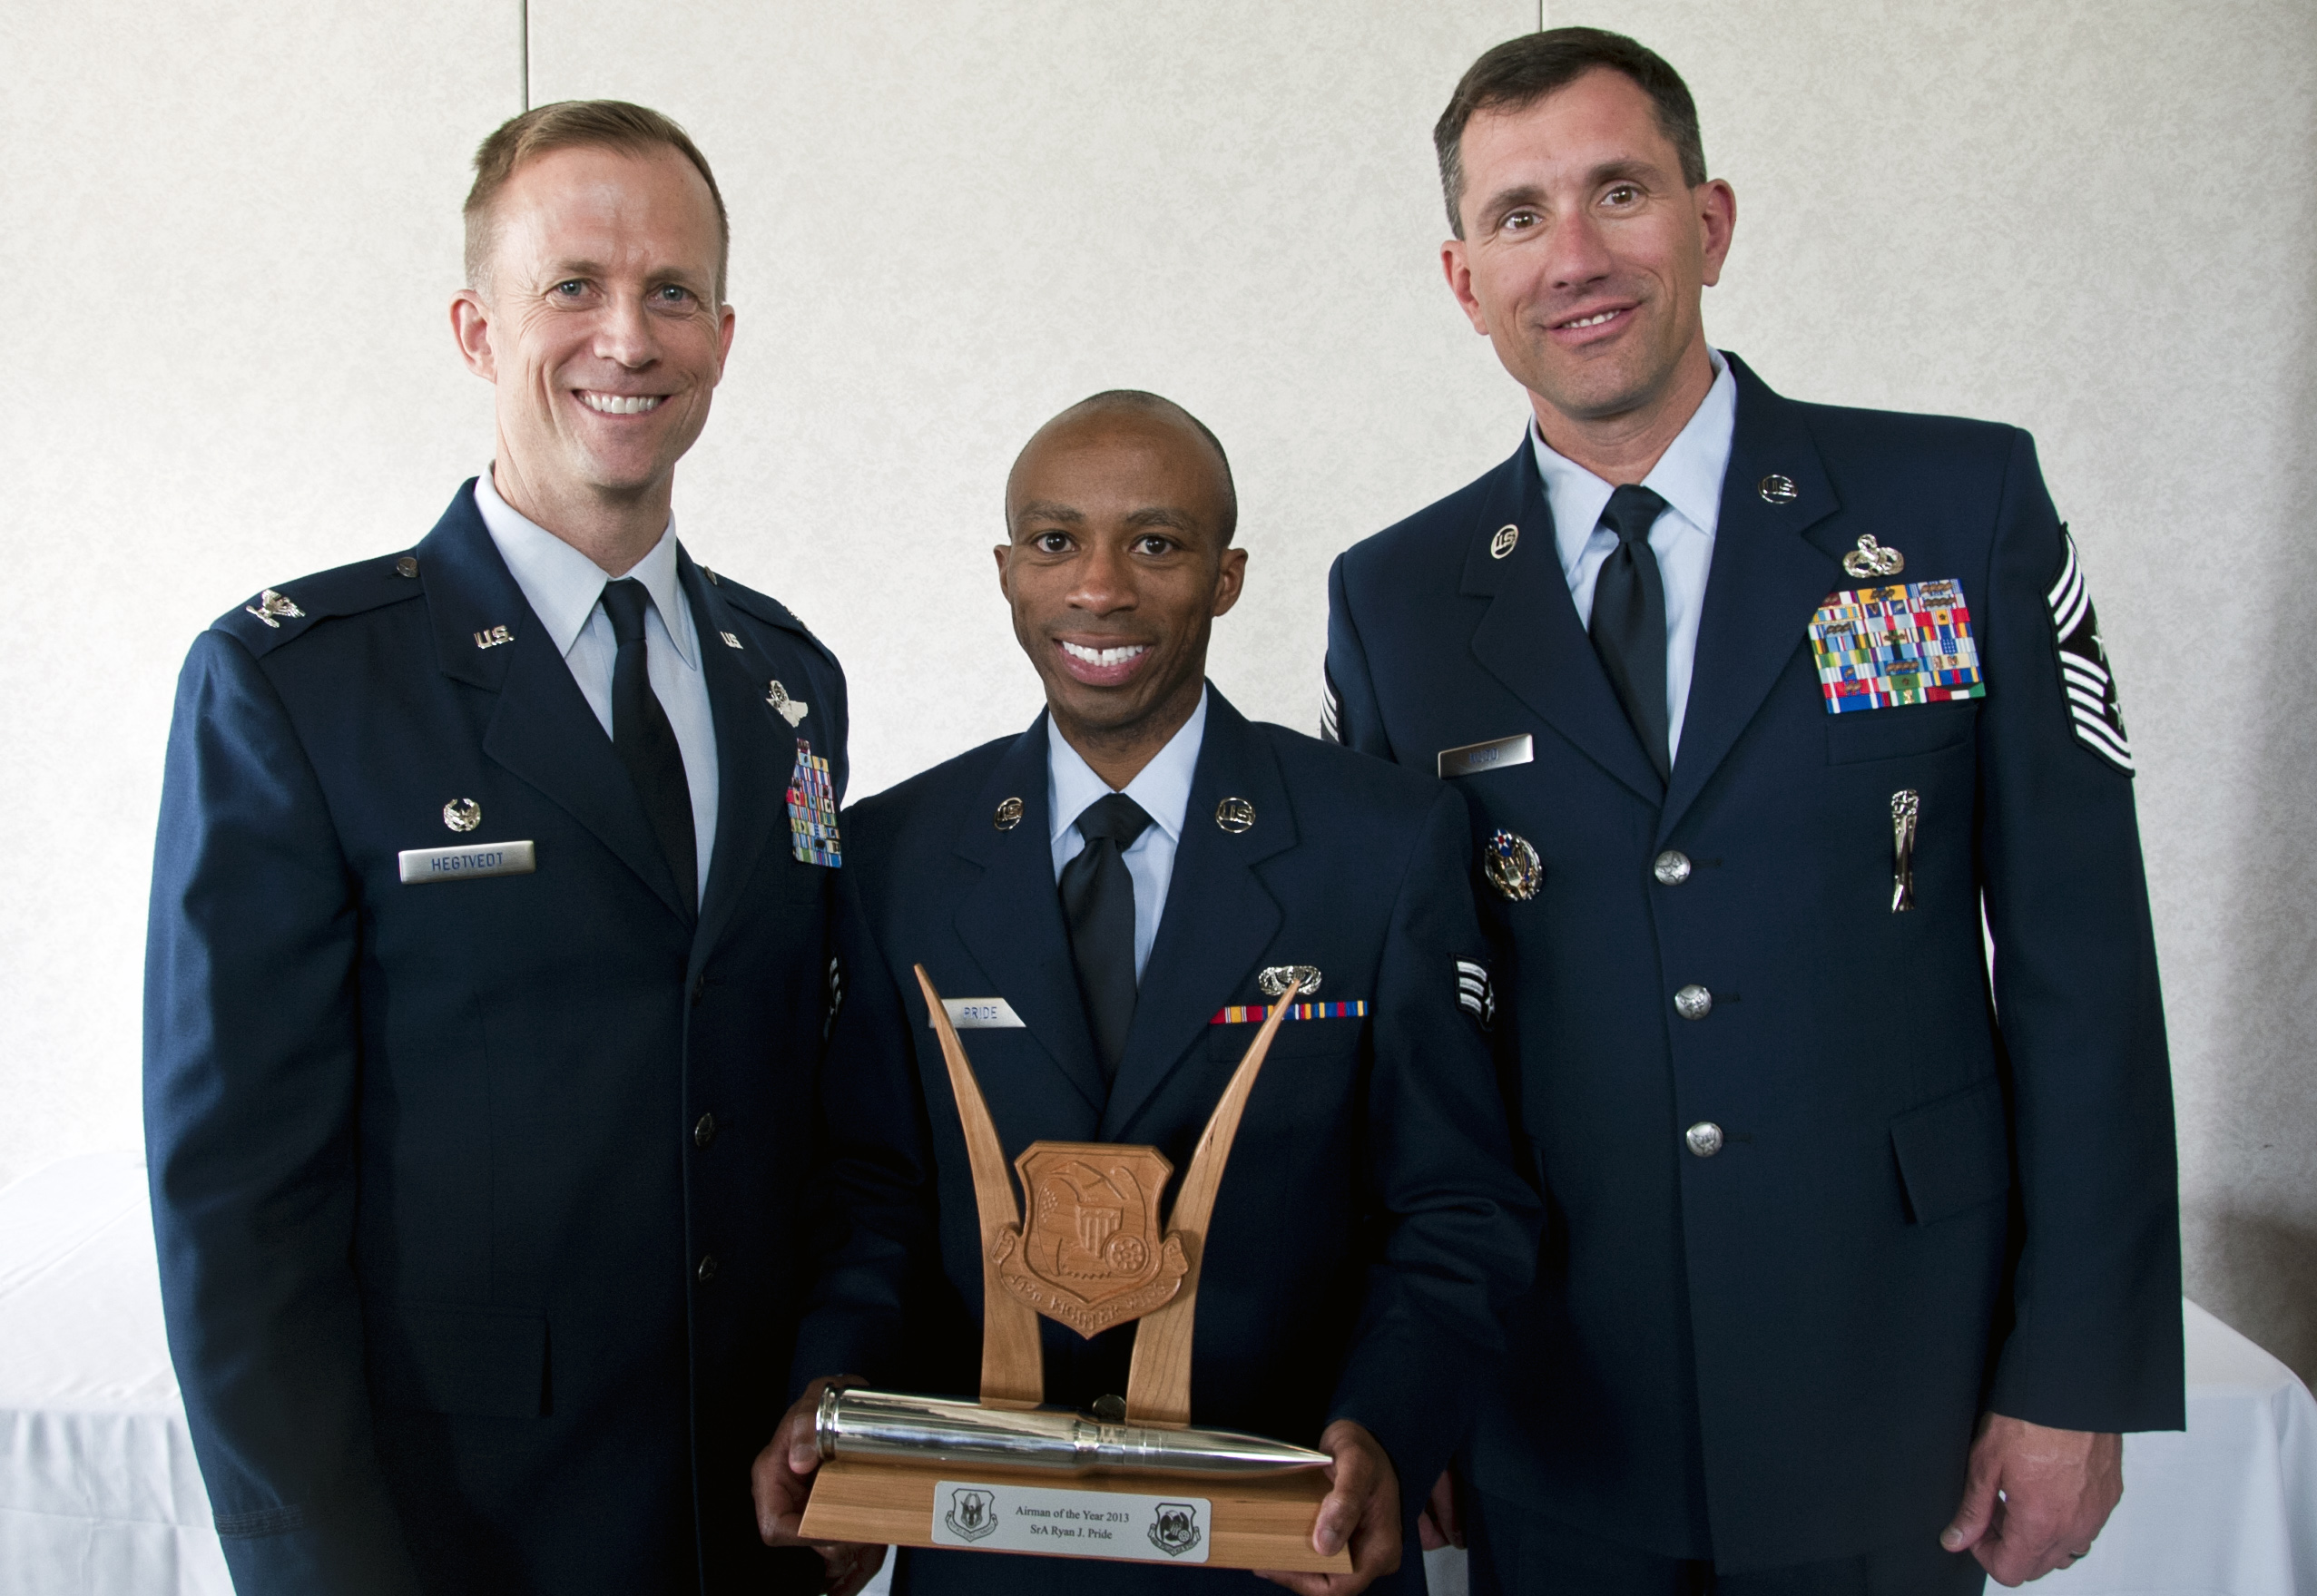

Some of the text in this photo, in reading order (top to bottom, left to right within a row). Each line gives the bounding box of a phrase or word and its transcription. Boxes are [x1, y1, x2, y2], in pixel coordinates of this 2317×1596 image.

[431, 851, 504, 872] HEGTVEDT
[963, 1006, 997, 1019] PRIDE
[1015, 1505, 1129, 1523] Airman of the Year 2013
[1029, 1523, 1113, 1540] SrA Ryan J. Pride
